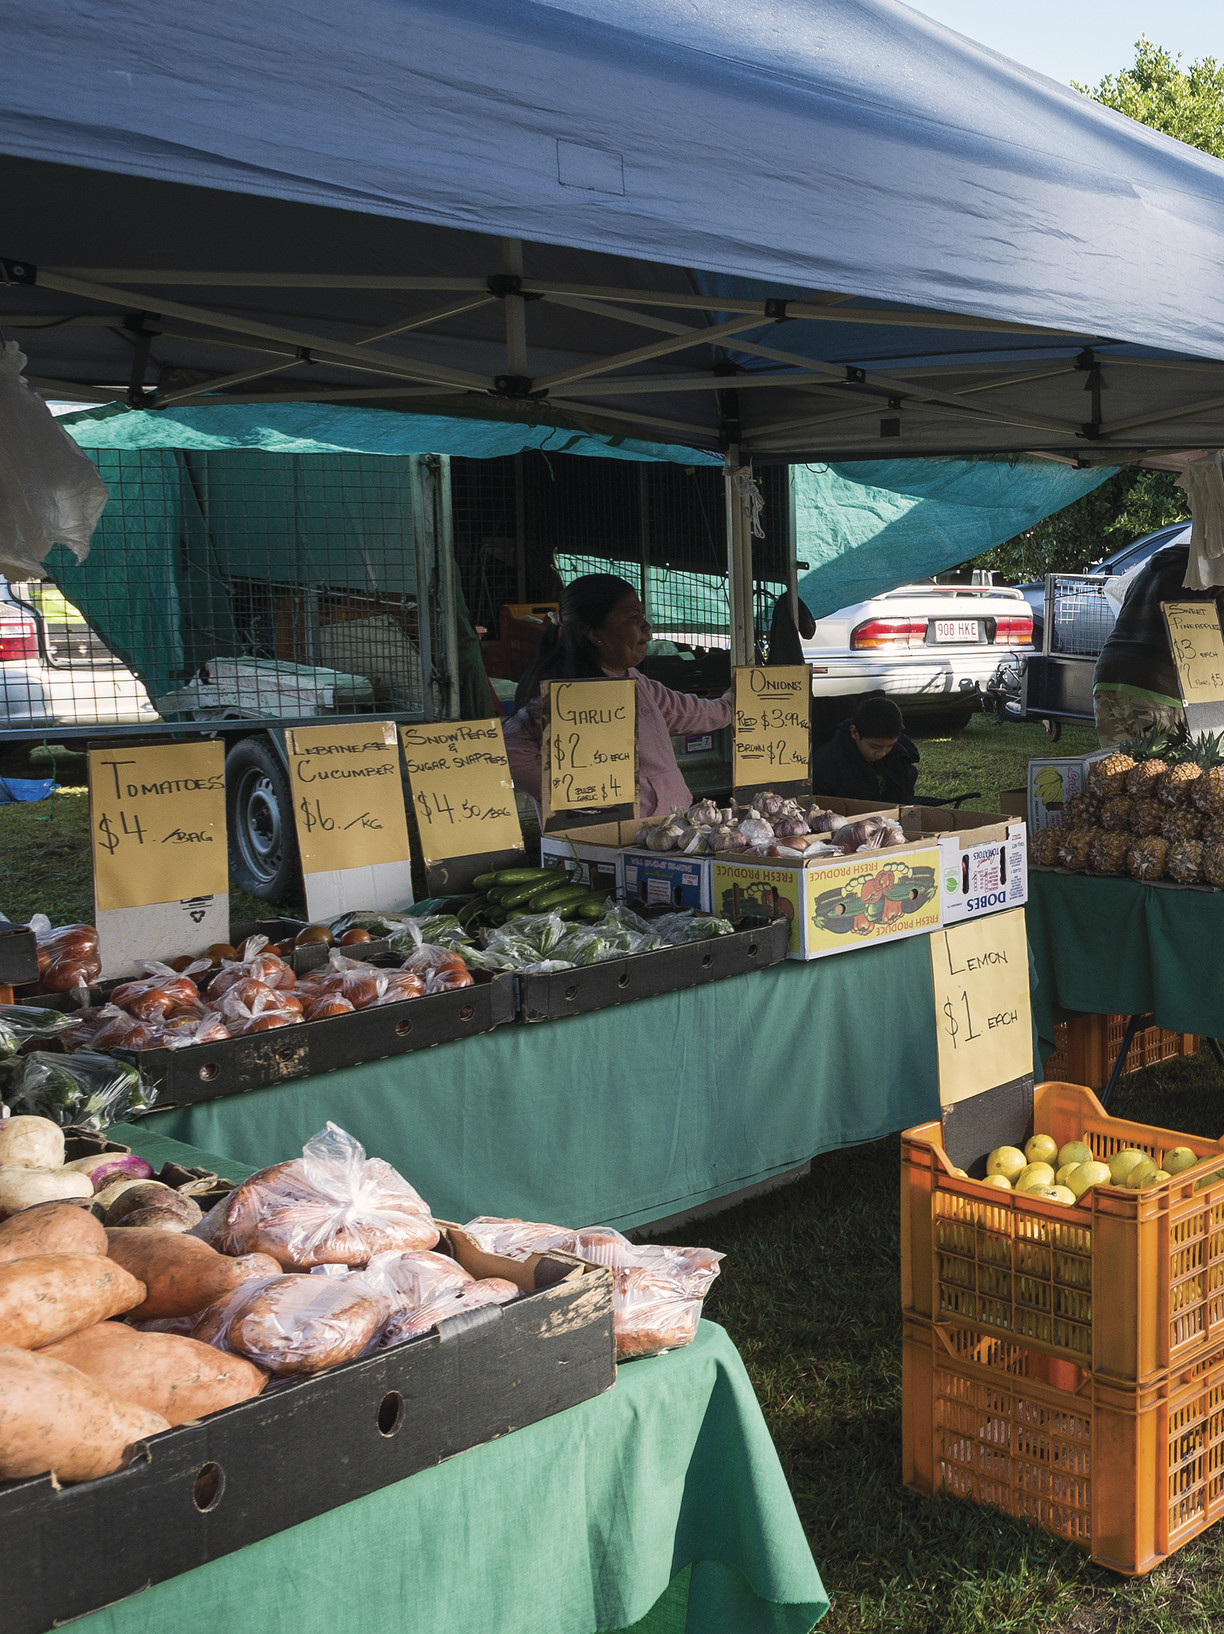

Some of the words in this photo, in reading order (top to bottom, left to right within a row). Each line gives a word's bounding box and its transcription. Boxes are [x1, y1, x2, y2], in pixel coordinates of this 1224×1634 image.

[937, 623, 955, 636] 908
[958, 623, 977, 636] HKE
[750, 669, 802, 692] ONIONS
[556, 683, 626, 725] GARLIC
[737, 710, 758, 727] RED
[290, 729, 391, 756] LEBANESE
[405, 728, 458, 748] SNOW
[457, 726, 498, 741] PEAS
[448, 743, 458, 753] &
[737, 742, 765, 753] BROWN
[298, 760, 395, 783] CUCUMBER
[407, 758, 450, 773] SUGAR
[100, 760, 224, 800] TOMATOES
[716, 865, 760, 880] PRODUCE
[809, 867, 851, 882] PRODUCE
[853, 861, 878, 873] FRESH
[763, 871, 793, 884] FRESH
[966, 891, 1006, 912] DOBES
[875, 920, 914, 937] PRODUCE
[915, 913, 939, 928] FRESH
[944, 931, 1008, 976] LEMON
[987, 1010, 1018, 1030] EACH
